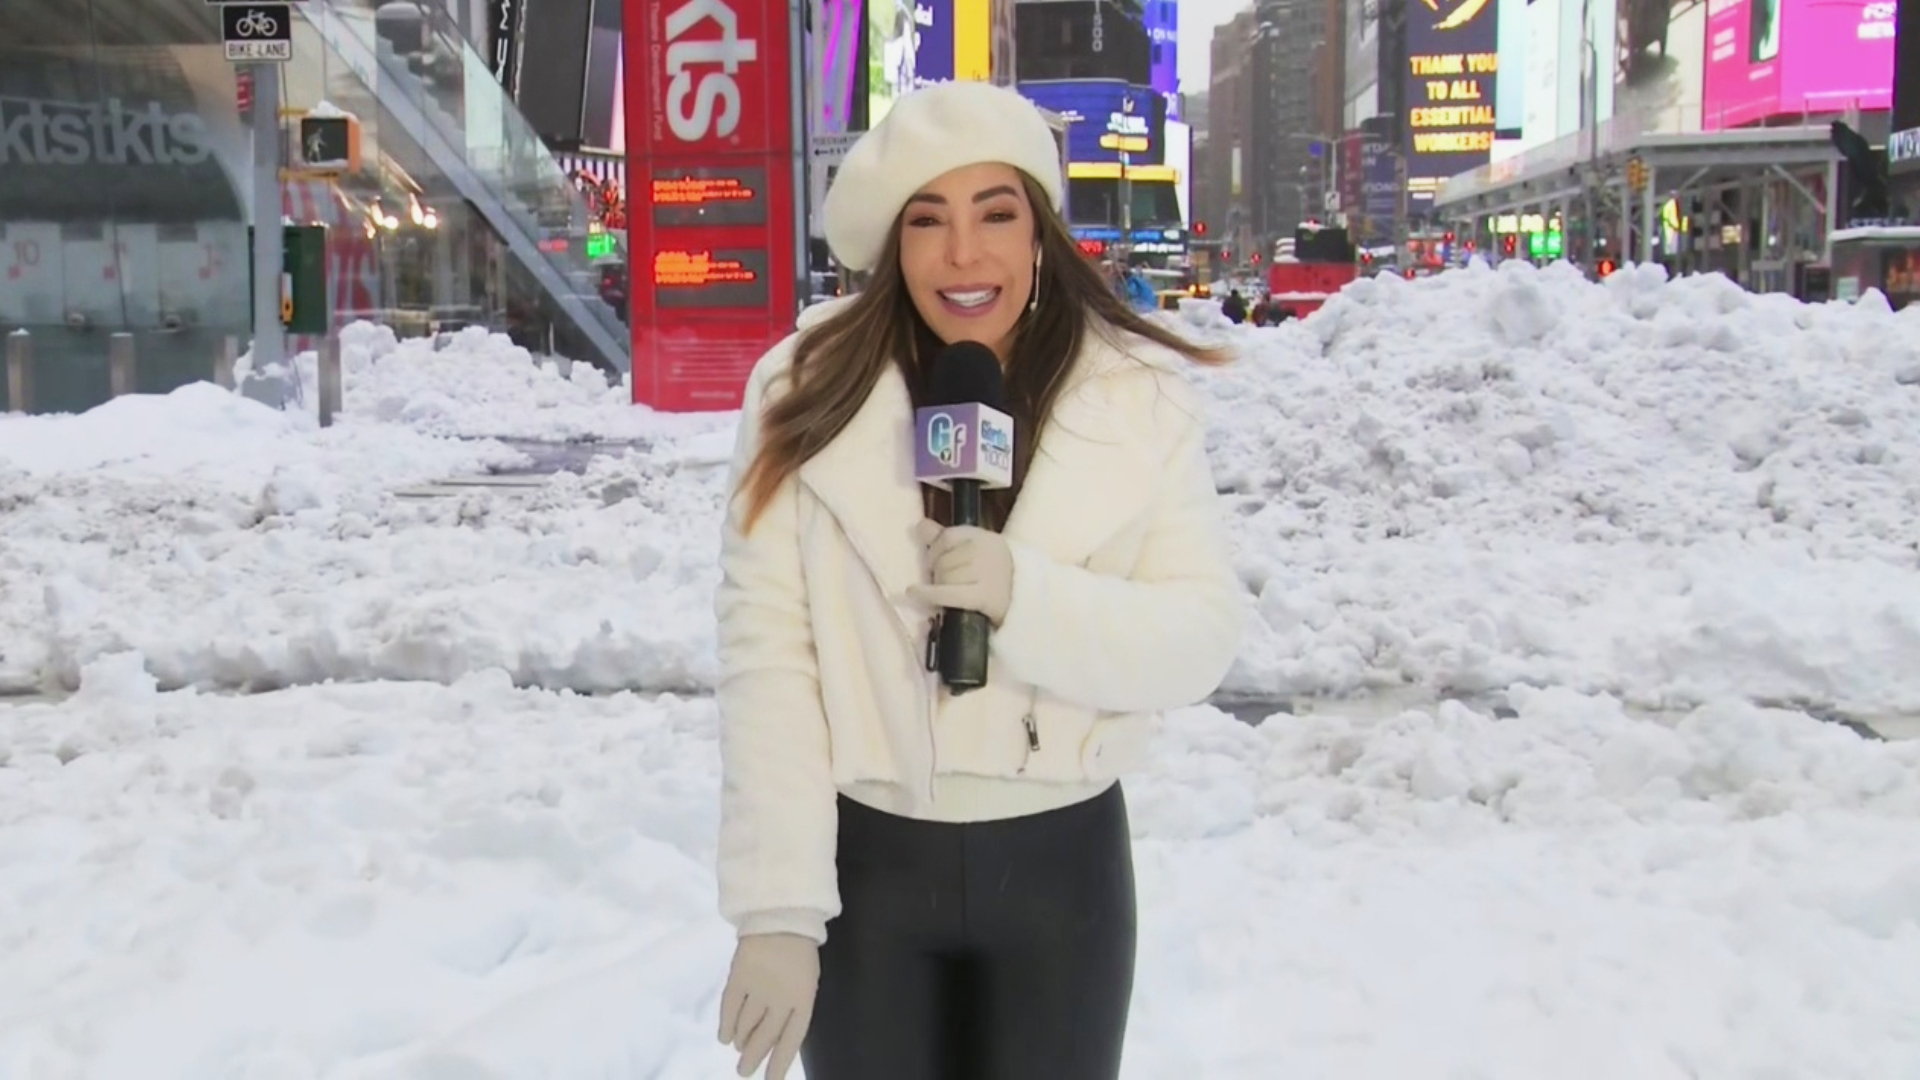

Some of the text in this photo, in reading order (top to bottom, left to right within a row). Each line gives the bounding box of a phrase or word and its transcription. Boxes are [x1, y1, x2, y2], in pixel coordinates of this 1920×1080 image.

[228, 43, 286, 57] BIKE LANE
[1410, 53, 1498, 75] THANK YOU
[1426, 80, 1481, 100] TO ALL
[1410, 105, 1495, 127] ESSENTIAL
[1414, 131, 1496, 152] WORKERS!
